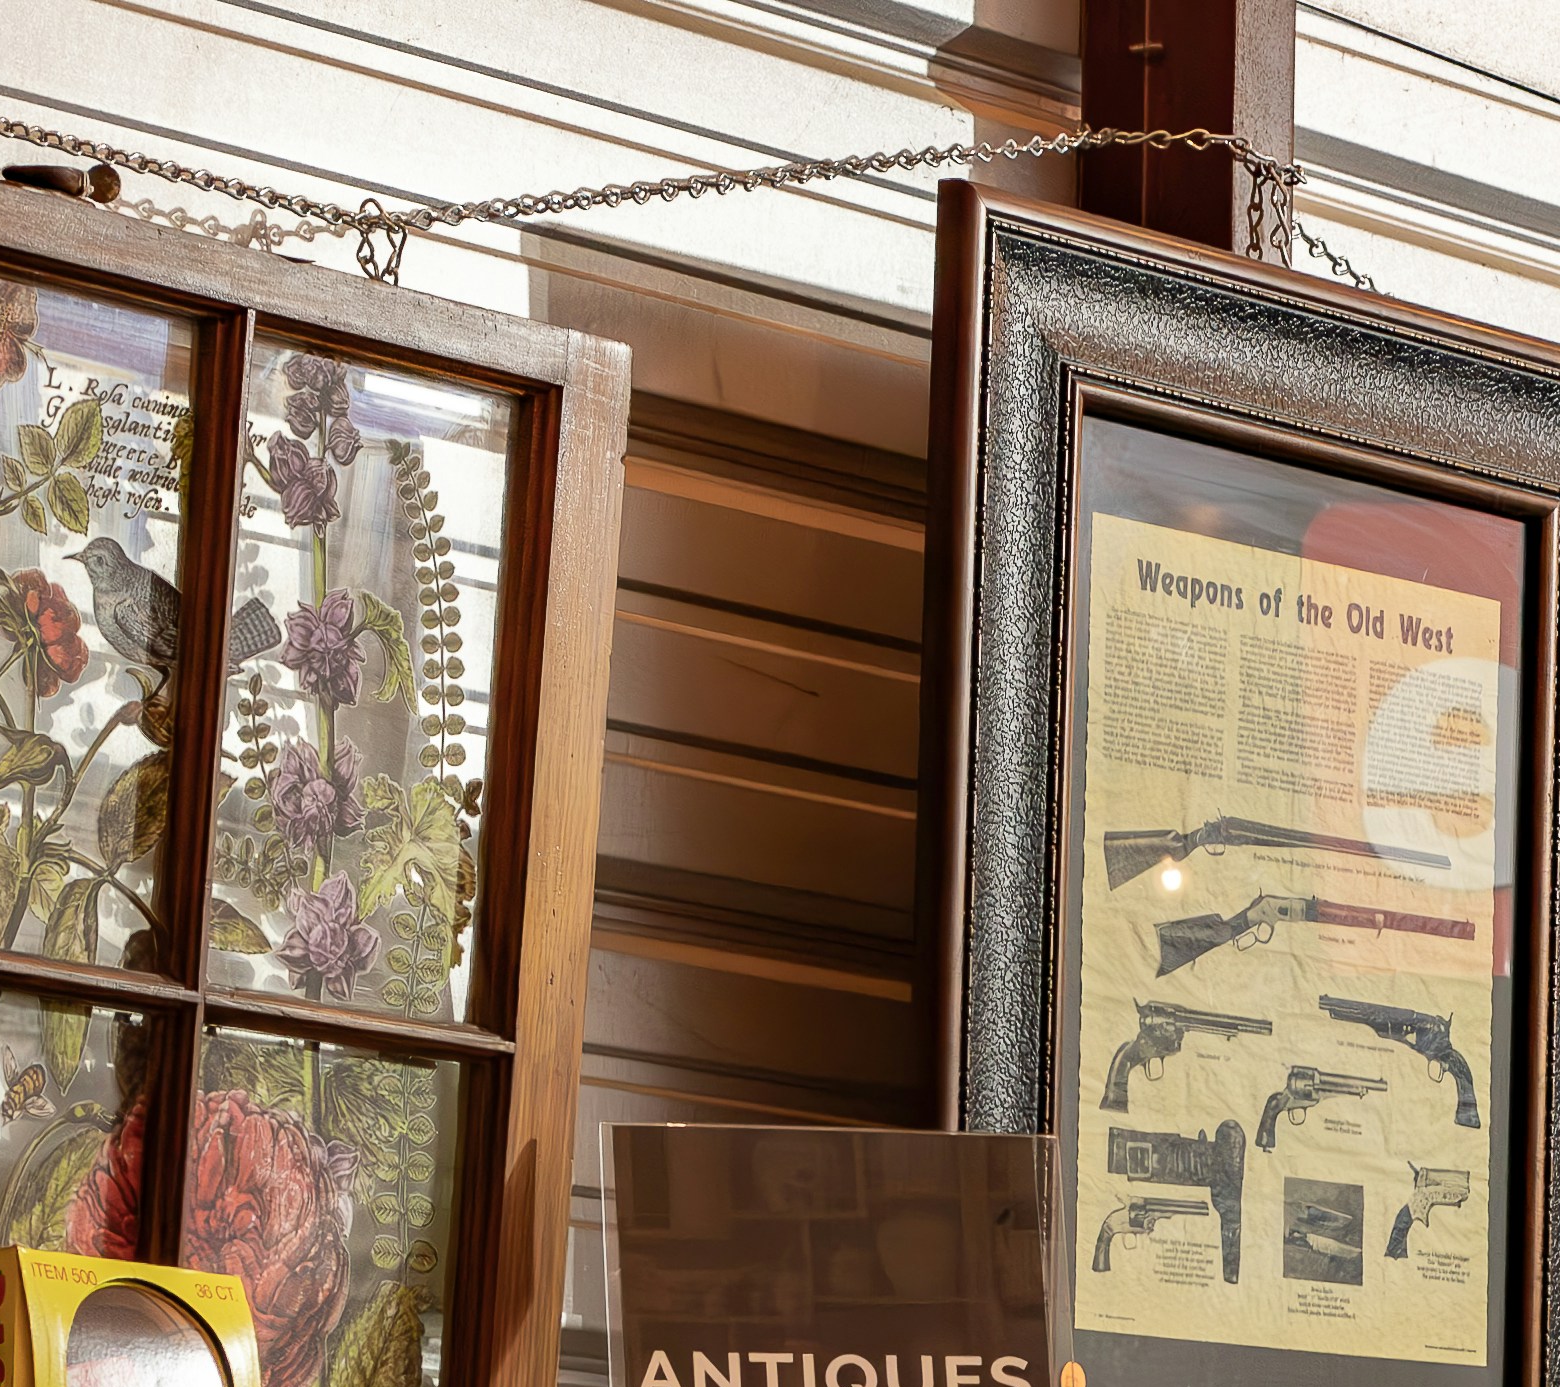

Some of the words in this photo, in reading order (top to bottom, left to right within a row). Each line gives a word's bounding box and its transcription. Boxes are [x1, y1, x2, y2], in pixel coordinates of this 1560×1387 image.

[1137, 557, 1245, 611] Weapons
[1258, 587, 1284, 618] of
[1296, 594, 1333, 629] the
[1345, 602, 1385, 640] Old
[1397, 612, 1455, 655] West
[30, 1261, 69, 1283] ITEM
[70, 1265, 98, 1287] 500
[193, 1282, 213, 1299] 36
